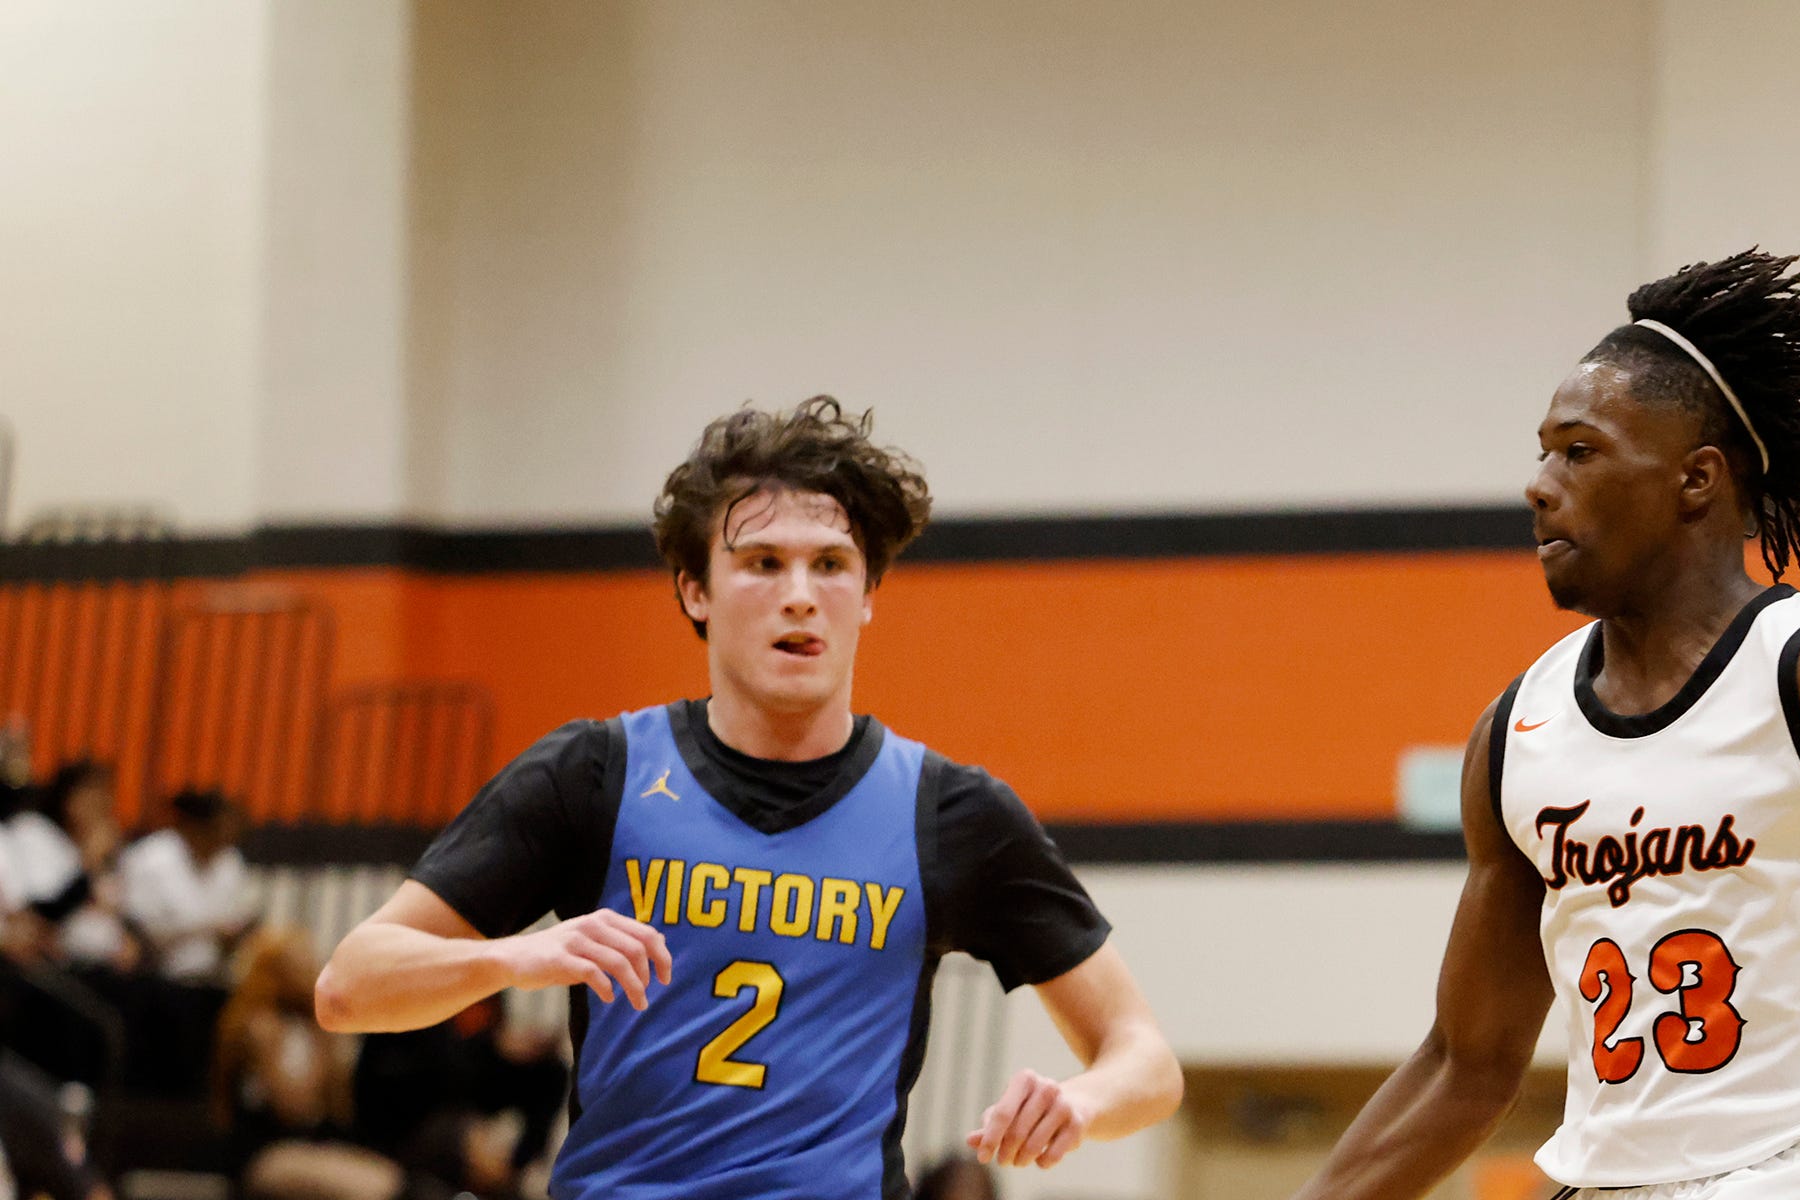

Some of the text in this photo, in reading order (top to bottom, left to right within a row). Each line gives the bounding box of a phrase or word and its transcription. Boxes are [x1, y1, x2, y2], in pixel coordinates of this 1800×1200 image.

[625, 857, 905, 951] VICTORY
[1535, 799, 1756, 908] Trojans
[693, 958, 785, 1090] 2
[1578, 927, 1749, 1085] 23
